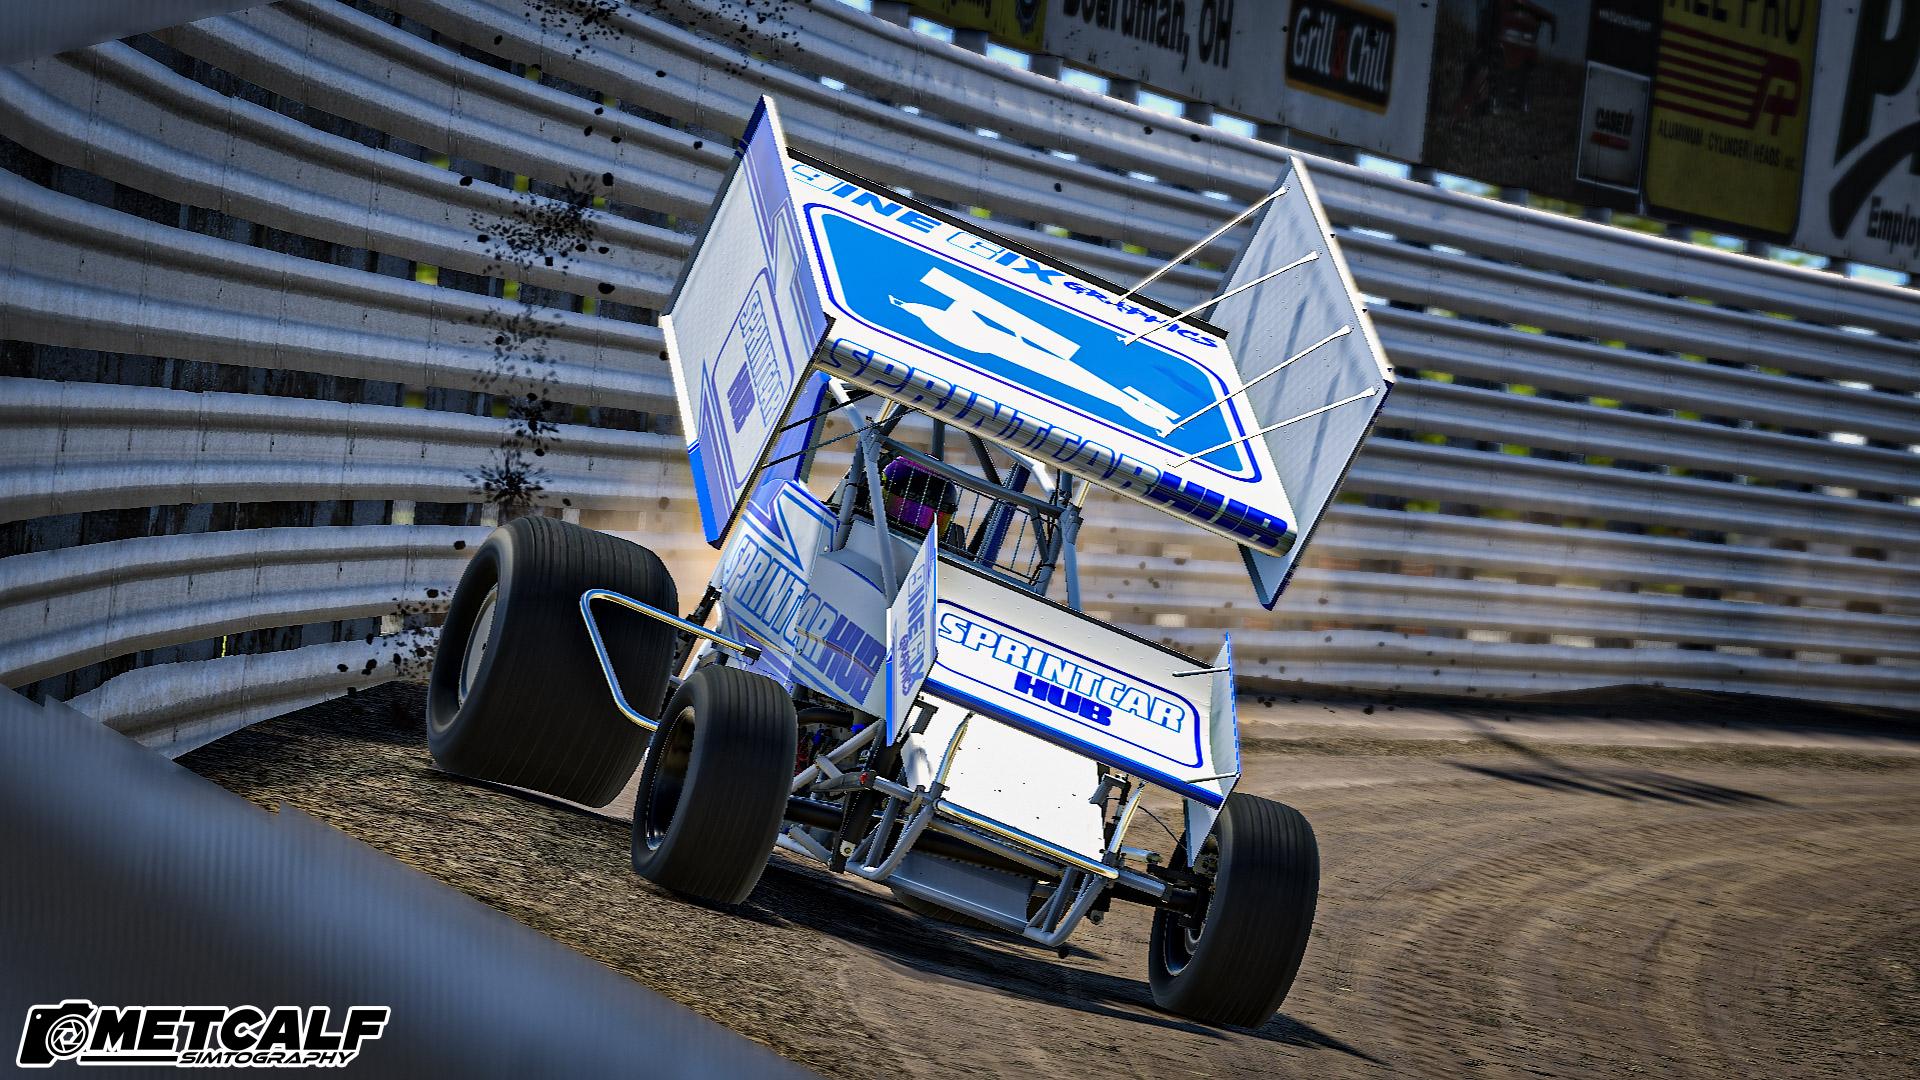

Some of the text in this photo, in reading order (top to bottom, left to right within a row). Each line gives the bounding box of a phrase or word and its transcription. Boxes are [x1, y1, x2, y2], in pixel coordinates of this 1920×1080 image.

[1064, 0, 1234, 73] ardman, OH
[1293, 7, 1336, 75] Grill
[1347, 23, 1390, 92] Chill
[1658, 119, 1704, 146] ALUMINUM
[1708, 132, 1750, 160] CYLINDER
[1752, 144, 1781, 167] HEADS
[738, 289, 785, 428] SPRINTCAR
[727, 361, 757, 434] HUB
[938, 612, 1186, 733] SPRINTCAR
[1013, 671, 1112, 727] HUB
